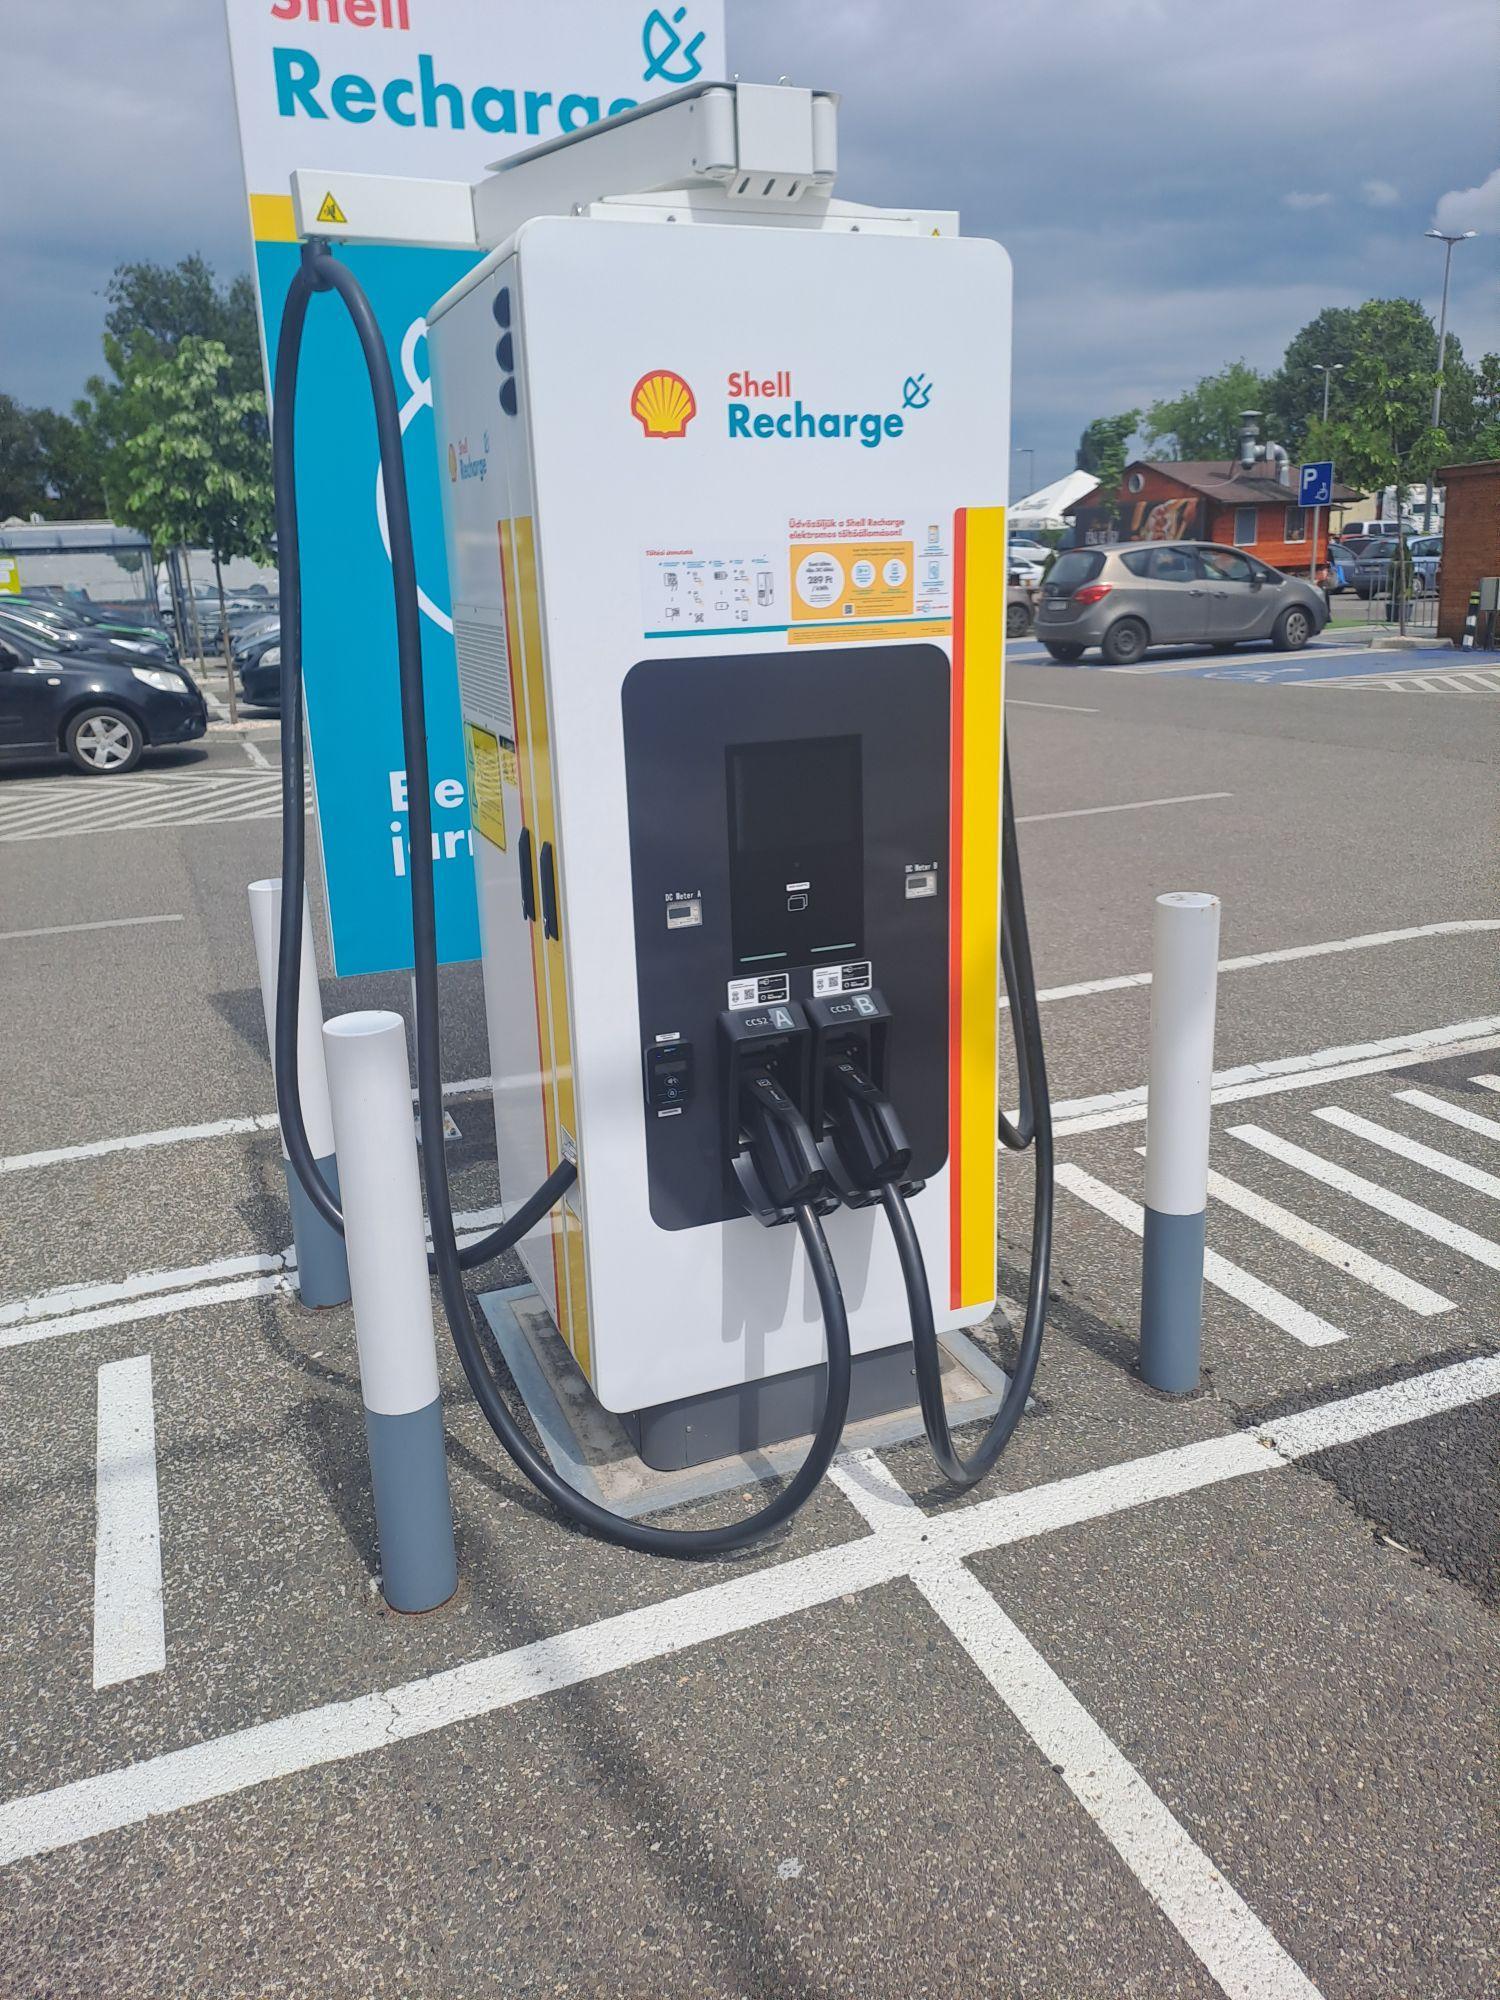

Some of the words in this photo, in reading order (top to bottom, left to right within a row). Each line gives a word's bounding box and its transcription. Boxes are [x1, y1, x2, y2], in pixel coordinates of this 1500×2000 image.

[727, 370, 791, 398] Shell
[728, 400, 904, 448] Recharge
[1303, 468, 1318, 490] P
[665, 893, 673, 902] DC
[675, 892, 694, 900] Meter
[697, 890, 702, 898] A
[829, 1003, 853, 1014] CCS2
[855, 997, 876, 1013] B
[745, 1017, 769, 1027] CCS2
[776, 1010, 793, 1027] A
